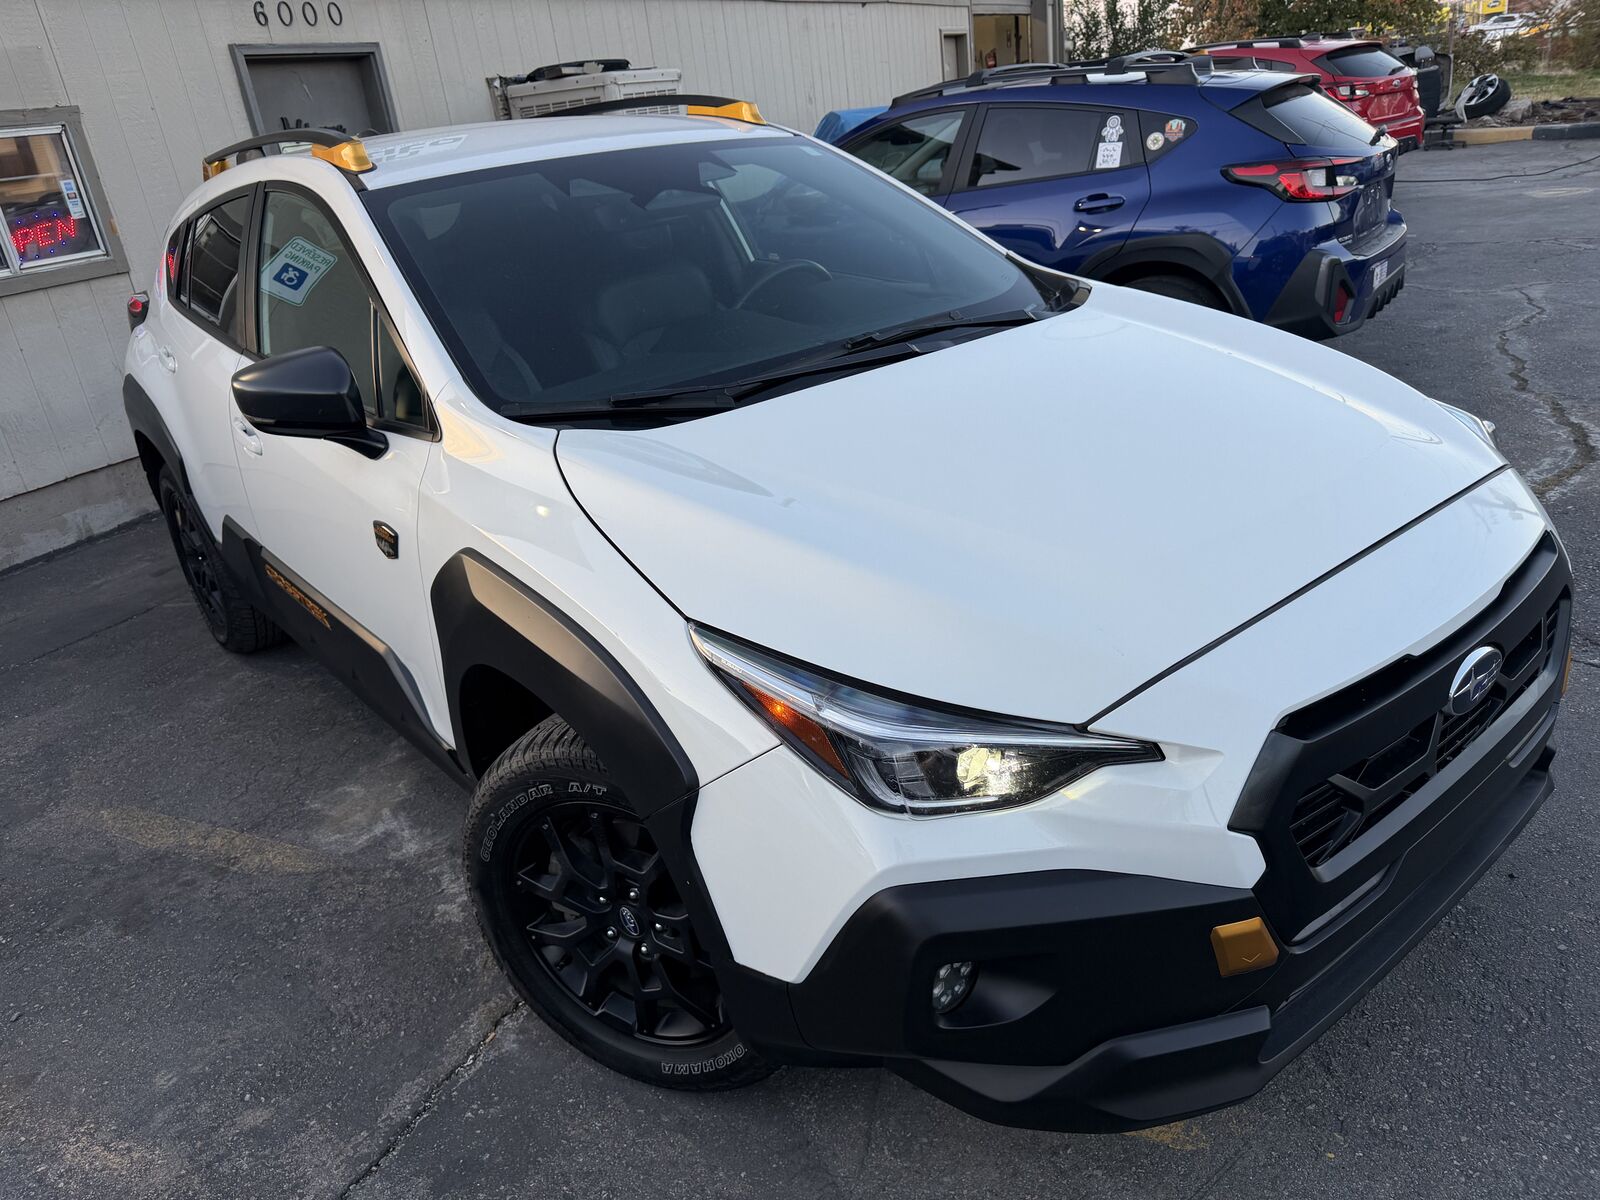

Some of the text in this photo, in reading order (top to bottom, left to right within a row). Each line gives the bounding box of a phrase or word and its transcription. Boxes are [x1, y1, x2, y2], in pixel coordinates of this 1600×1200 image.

[253, 0, 343, 27] 6000
[10, 215, 76, 253] PEN
[480, 782, 607, 862] GEOLANDAR A/T
[661, 1043, 748, 1075] OKOHAMA
